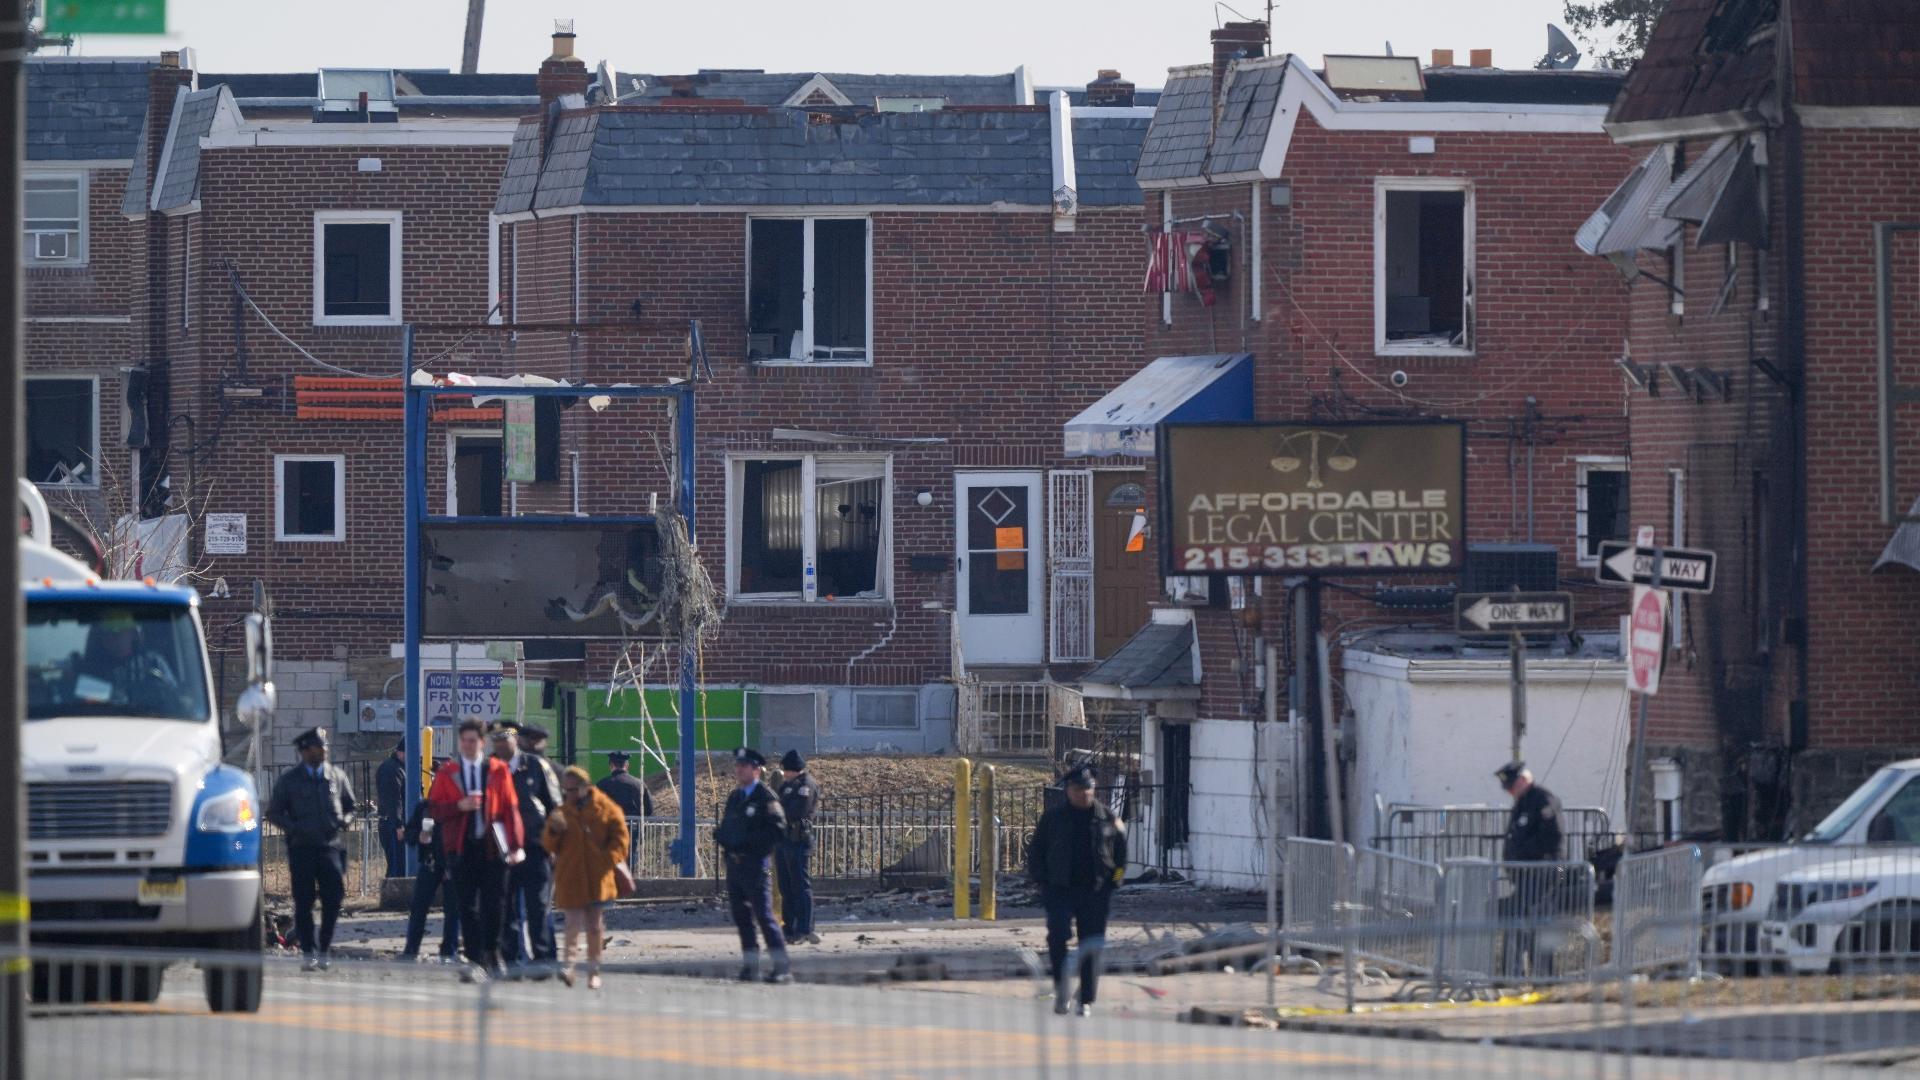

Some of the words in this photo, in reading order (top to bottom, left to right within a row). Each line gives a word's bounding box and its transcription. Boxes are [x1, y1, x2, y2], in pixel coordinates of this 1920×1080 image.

[1187, 489, 1447, 512] AFFORDABLE
[1186, 513, 1299, 545] LEGAL
[1308, 510, 1453, 542] CENTER
[1183, 542, 1452, 571] 215-333-LAWS
[1633, 557, 1658, 574] ON
[1668, 559, 1702, 579] WAY
[1490, 604, 1522, 621] ONE
[1527, 602, 1561, 620] WAY
[430, 675, 461, 687] NOTAY
[465, 675, 485, 687] TAGS
